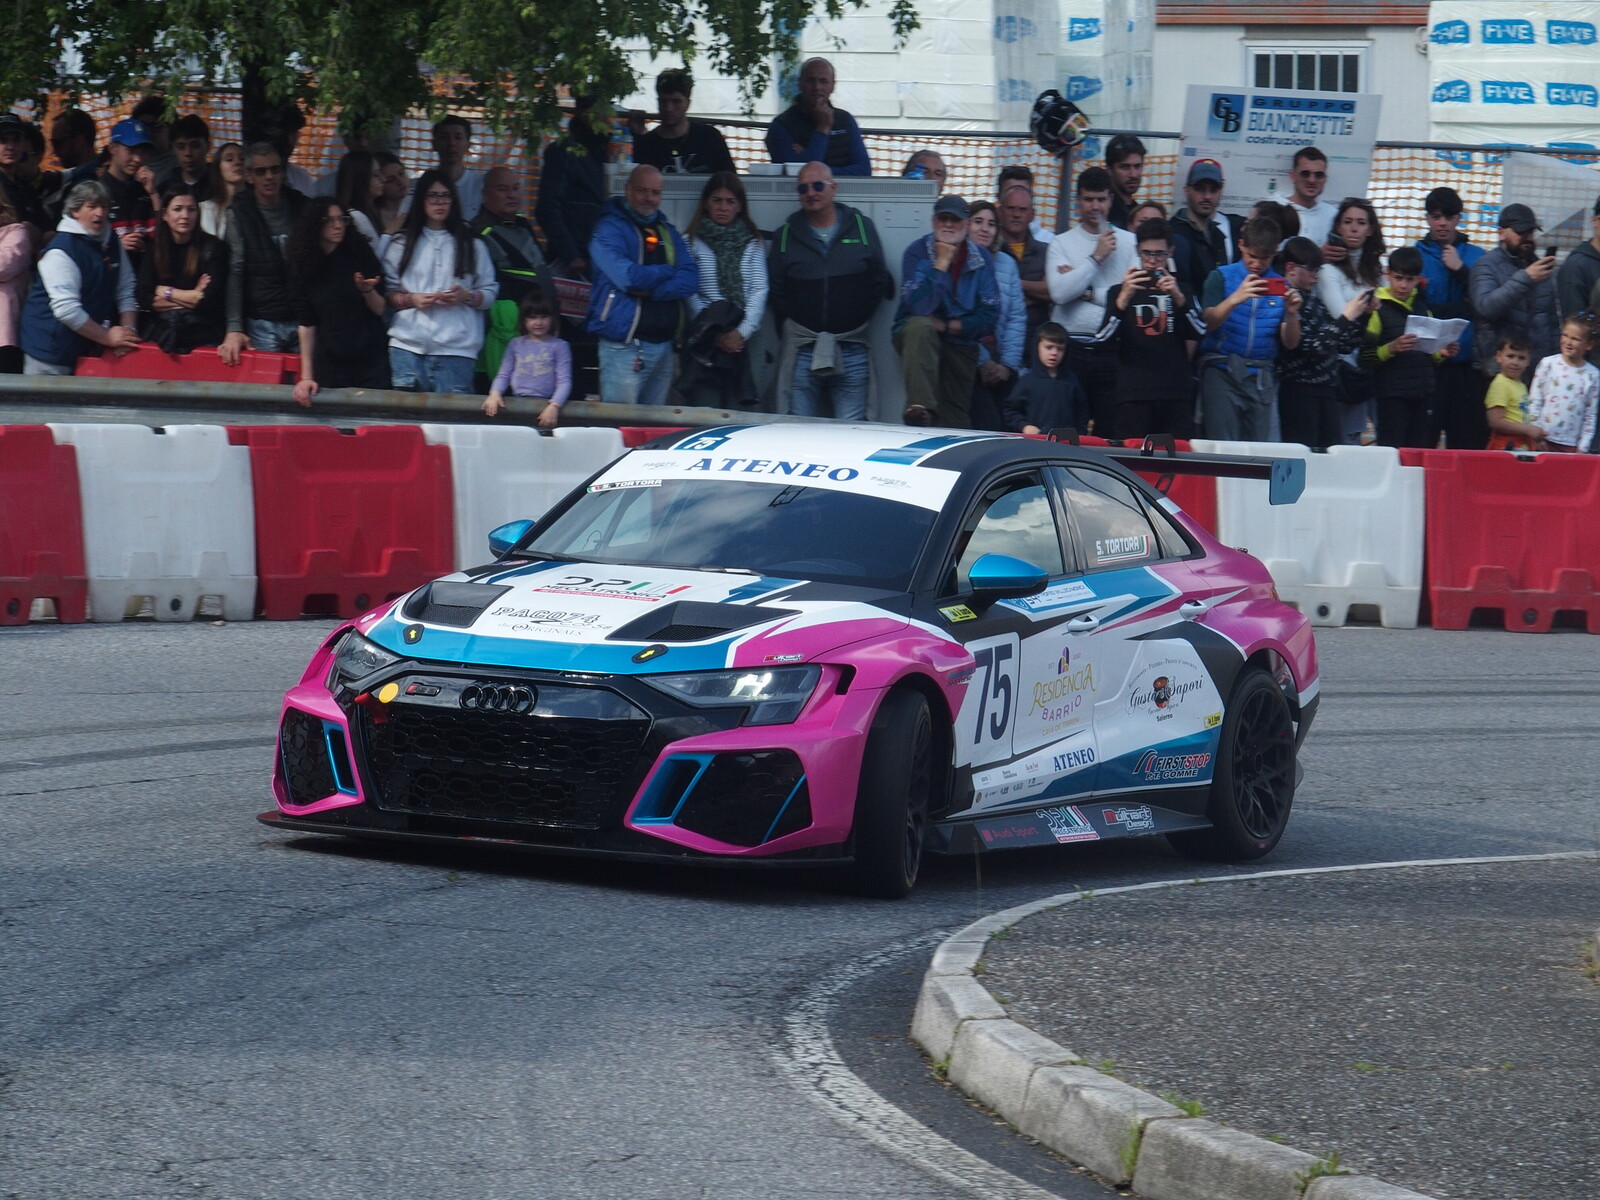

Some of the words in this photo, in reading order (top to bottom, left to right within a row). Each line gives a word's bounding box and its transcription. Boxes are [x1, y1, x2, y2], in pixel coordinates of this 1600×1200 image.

[1255, 98, 1355, 111] GRUPPO
[1247, 111, 1346, 136] BIANCHETTI
[1246, 134, 1314, 147] costruzioni
[683, 437, 723, 450] 75
[684, 457, 859, 482] ATENEO
[614, 479, 662, 488] TORTORA
[1096, 540, 1104, 555] S.
[1105, 535, 1140, 554] TORTORA
[540, 584, 667, 599] MECCATRONICA
[491, 606, 601, 624] PACO74
[973, 643, 1012, 745] 75
[1028, 663, 1095, 717] RESIDENCIA
[1041, 694, 1082, 722] BARRIO
[1156, 713, 1174, 723] Salerno
[1053, 747, 1095, 771] ATENEO
[1162, 769, 1198, 780] GOMME
[993, 829, 1012, 838] Audi
[1012, 826, 1040, 837] Sport
[1126, 820, 1154, 831] Design
